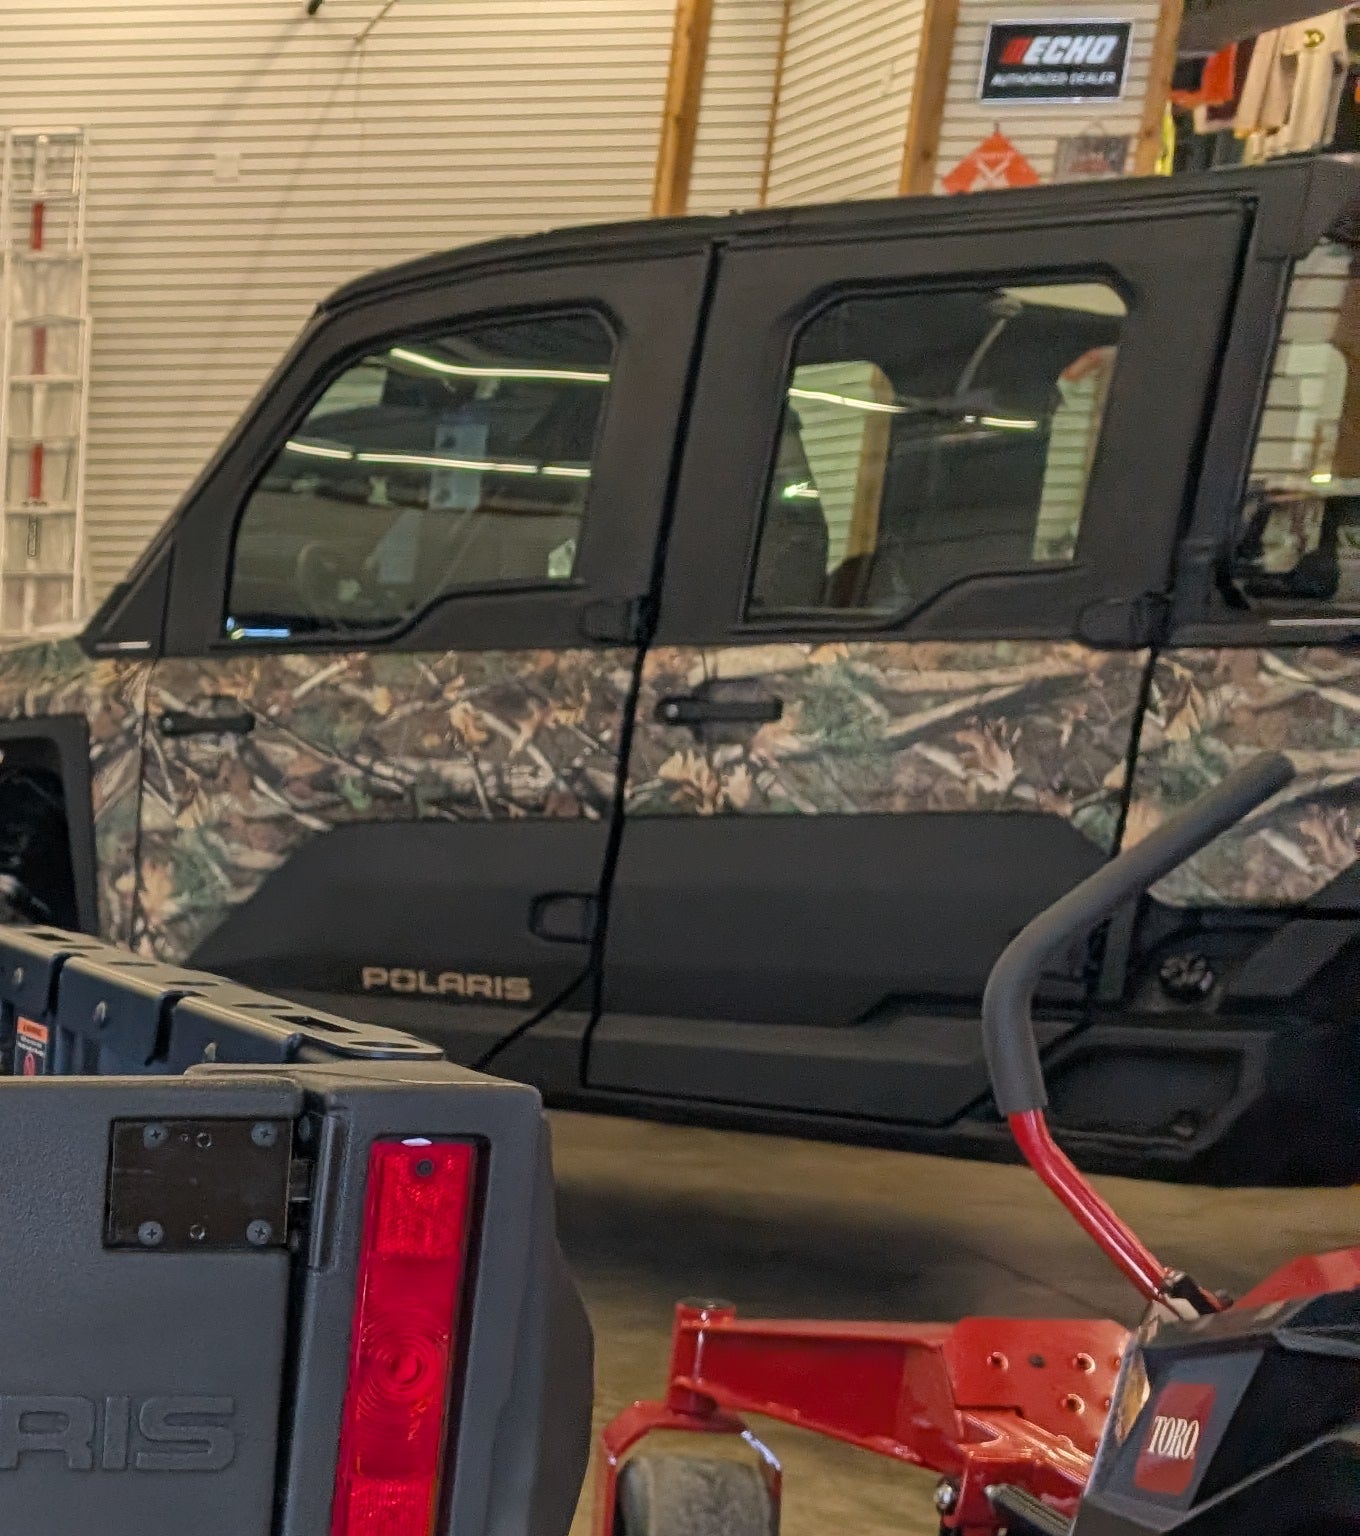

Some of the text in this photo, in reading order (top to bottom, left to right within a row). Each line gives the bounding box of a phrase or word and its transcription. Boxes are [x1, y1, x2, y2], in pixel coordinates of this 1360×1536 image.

[1022, 36, 1119, 65] ECHO
[990, 71, 1117, 87] AUTHORIZED DEALER
[362, 967, 532, 1001] POLARIS
[1147, 1415, 1200, 1460] TORO
